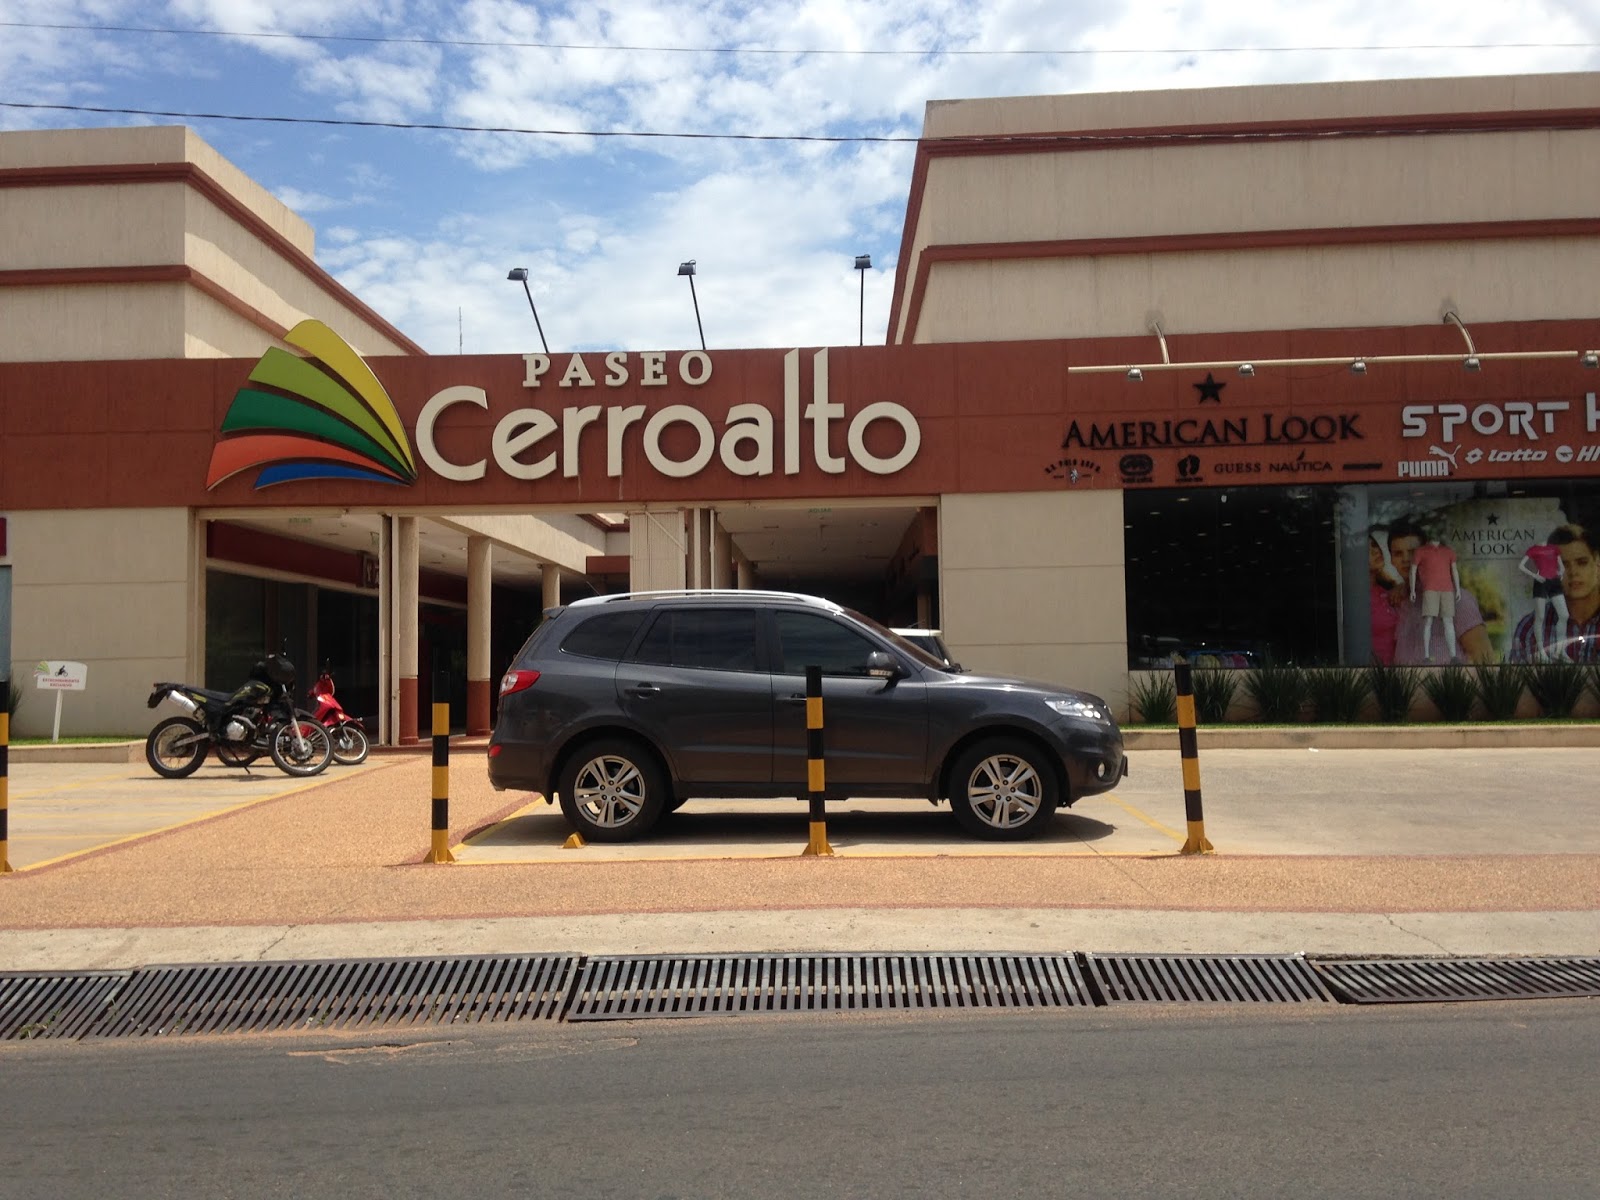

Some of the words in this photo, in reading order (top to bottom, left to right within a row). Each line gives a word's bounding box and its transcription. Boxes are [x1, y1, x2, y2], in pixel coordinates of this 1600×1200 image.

[521, 351, 713, 388] PASEO
[415, 347, 921, 482] Cerroalto
[1401, 401, 1571, 444] SPORT
[1061, 417, 1248, 450] AMERICAN
[1263, 412, 1365, 443] LOOK
[1214, 462, 1262, 474] GUESS
[1269, 461, 1334, 473] NAUTICA
[1398, 460, 1450, 478] PUMA
[1451, 529, 1536, 542] AMERICAN
[1472, 542, 1516, 555] LOOK
